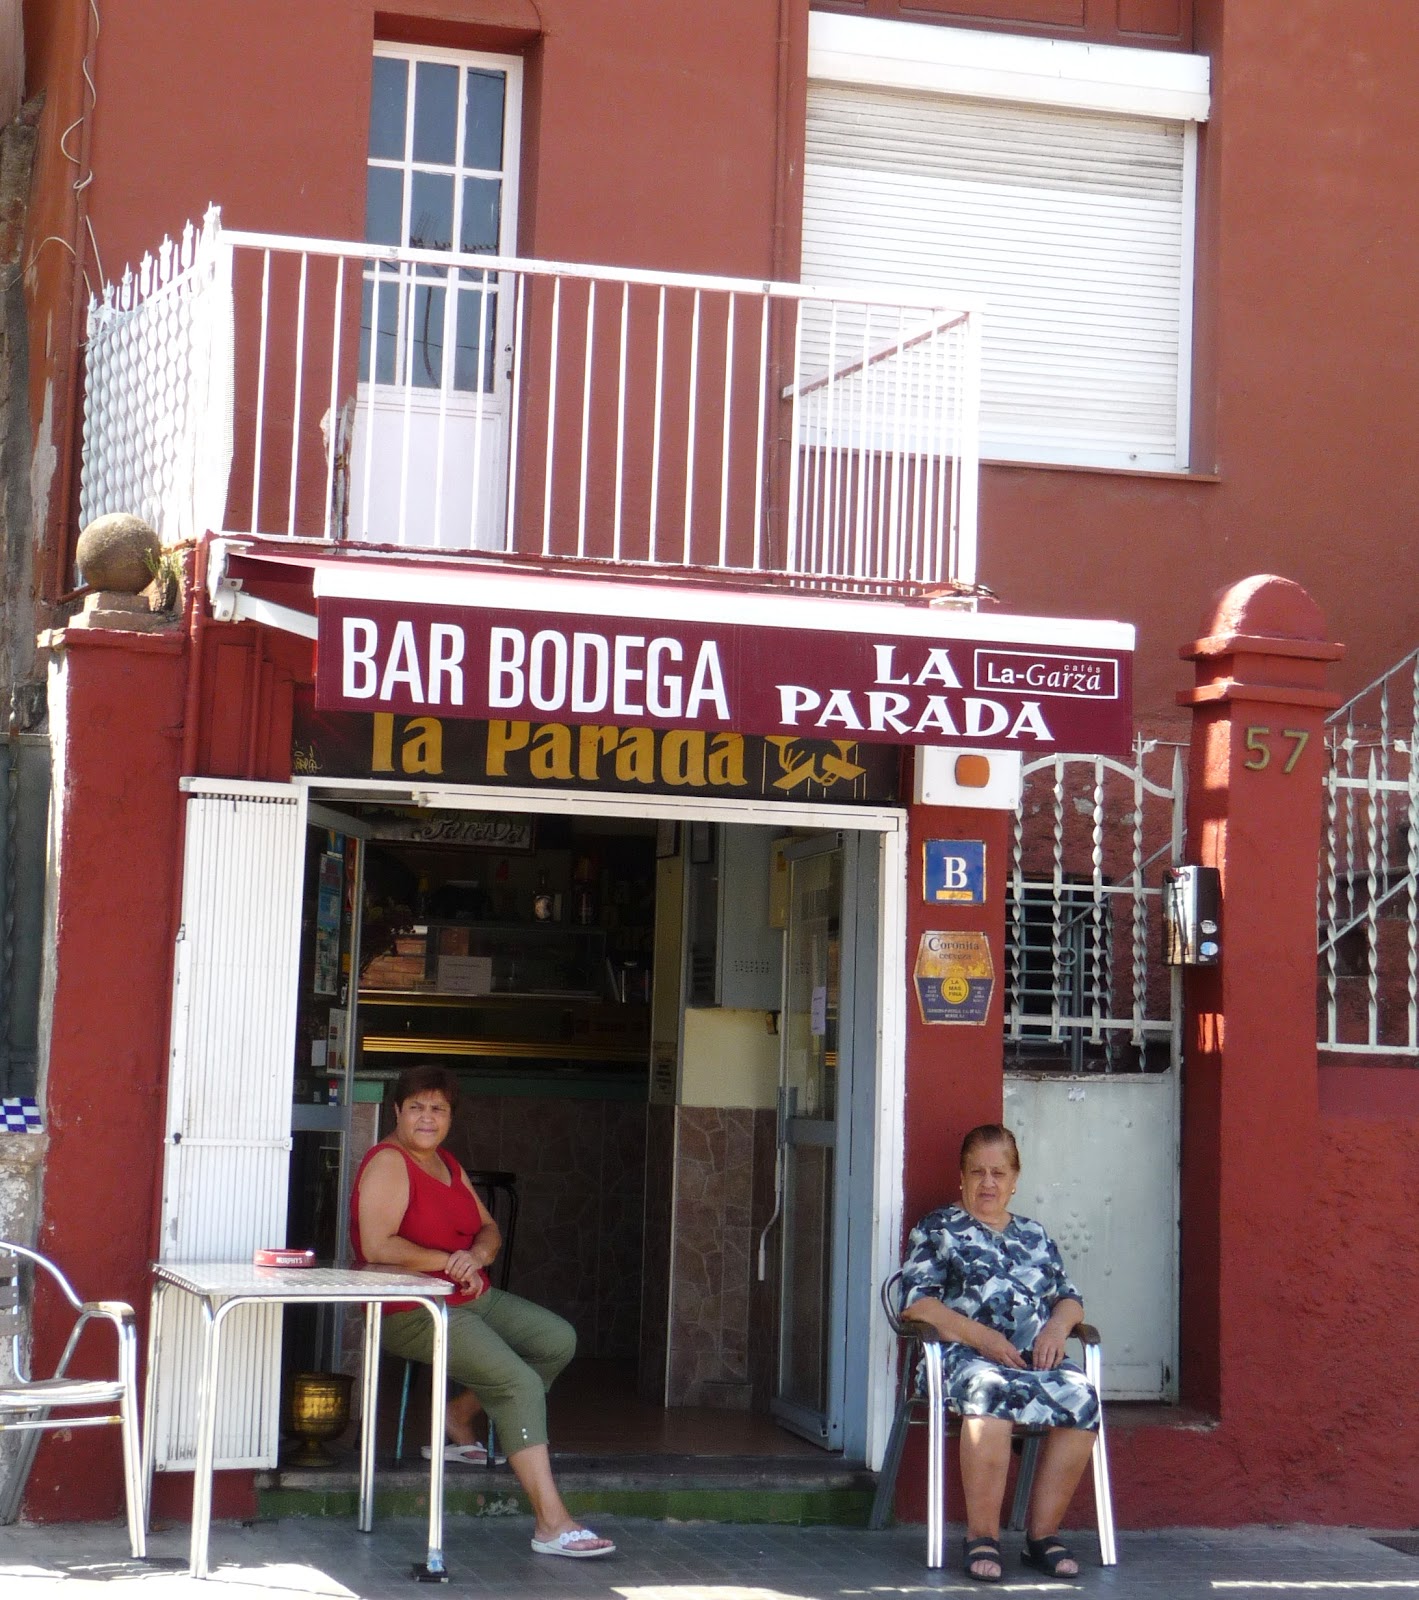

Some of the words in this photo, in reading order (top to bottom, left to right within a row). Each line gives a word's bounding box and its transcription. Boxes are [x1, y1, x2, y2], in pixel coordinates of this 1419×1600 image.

[342, 616, 465, 706] BAR
[488, 626, 731, 721] BODEGA
[873, 644, 963, 689] LA
[987, 661, 1102, 692] La-Garza
[1064, 663, 1101, 674] cafés
[774, 685, 1056, 742] PARADA
[1244, 726, 1310, 774] 57
[943, 856, 968, 889] B
[928, 937, 980, 952] Coronita
